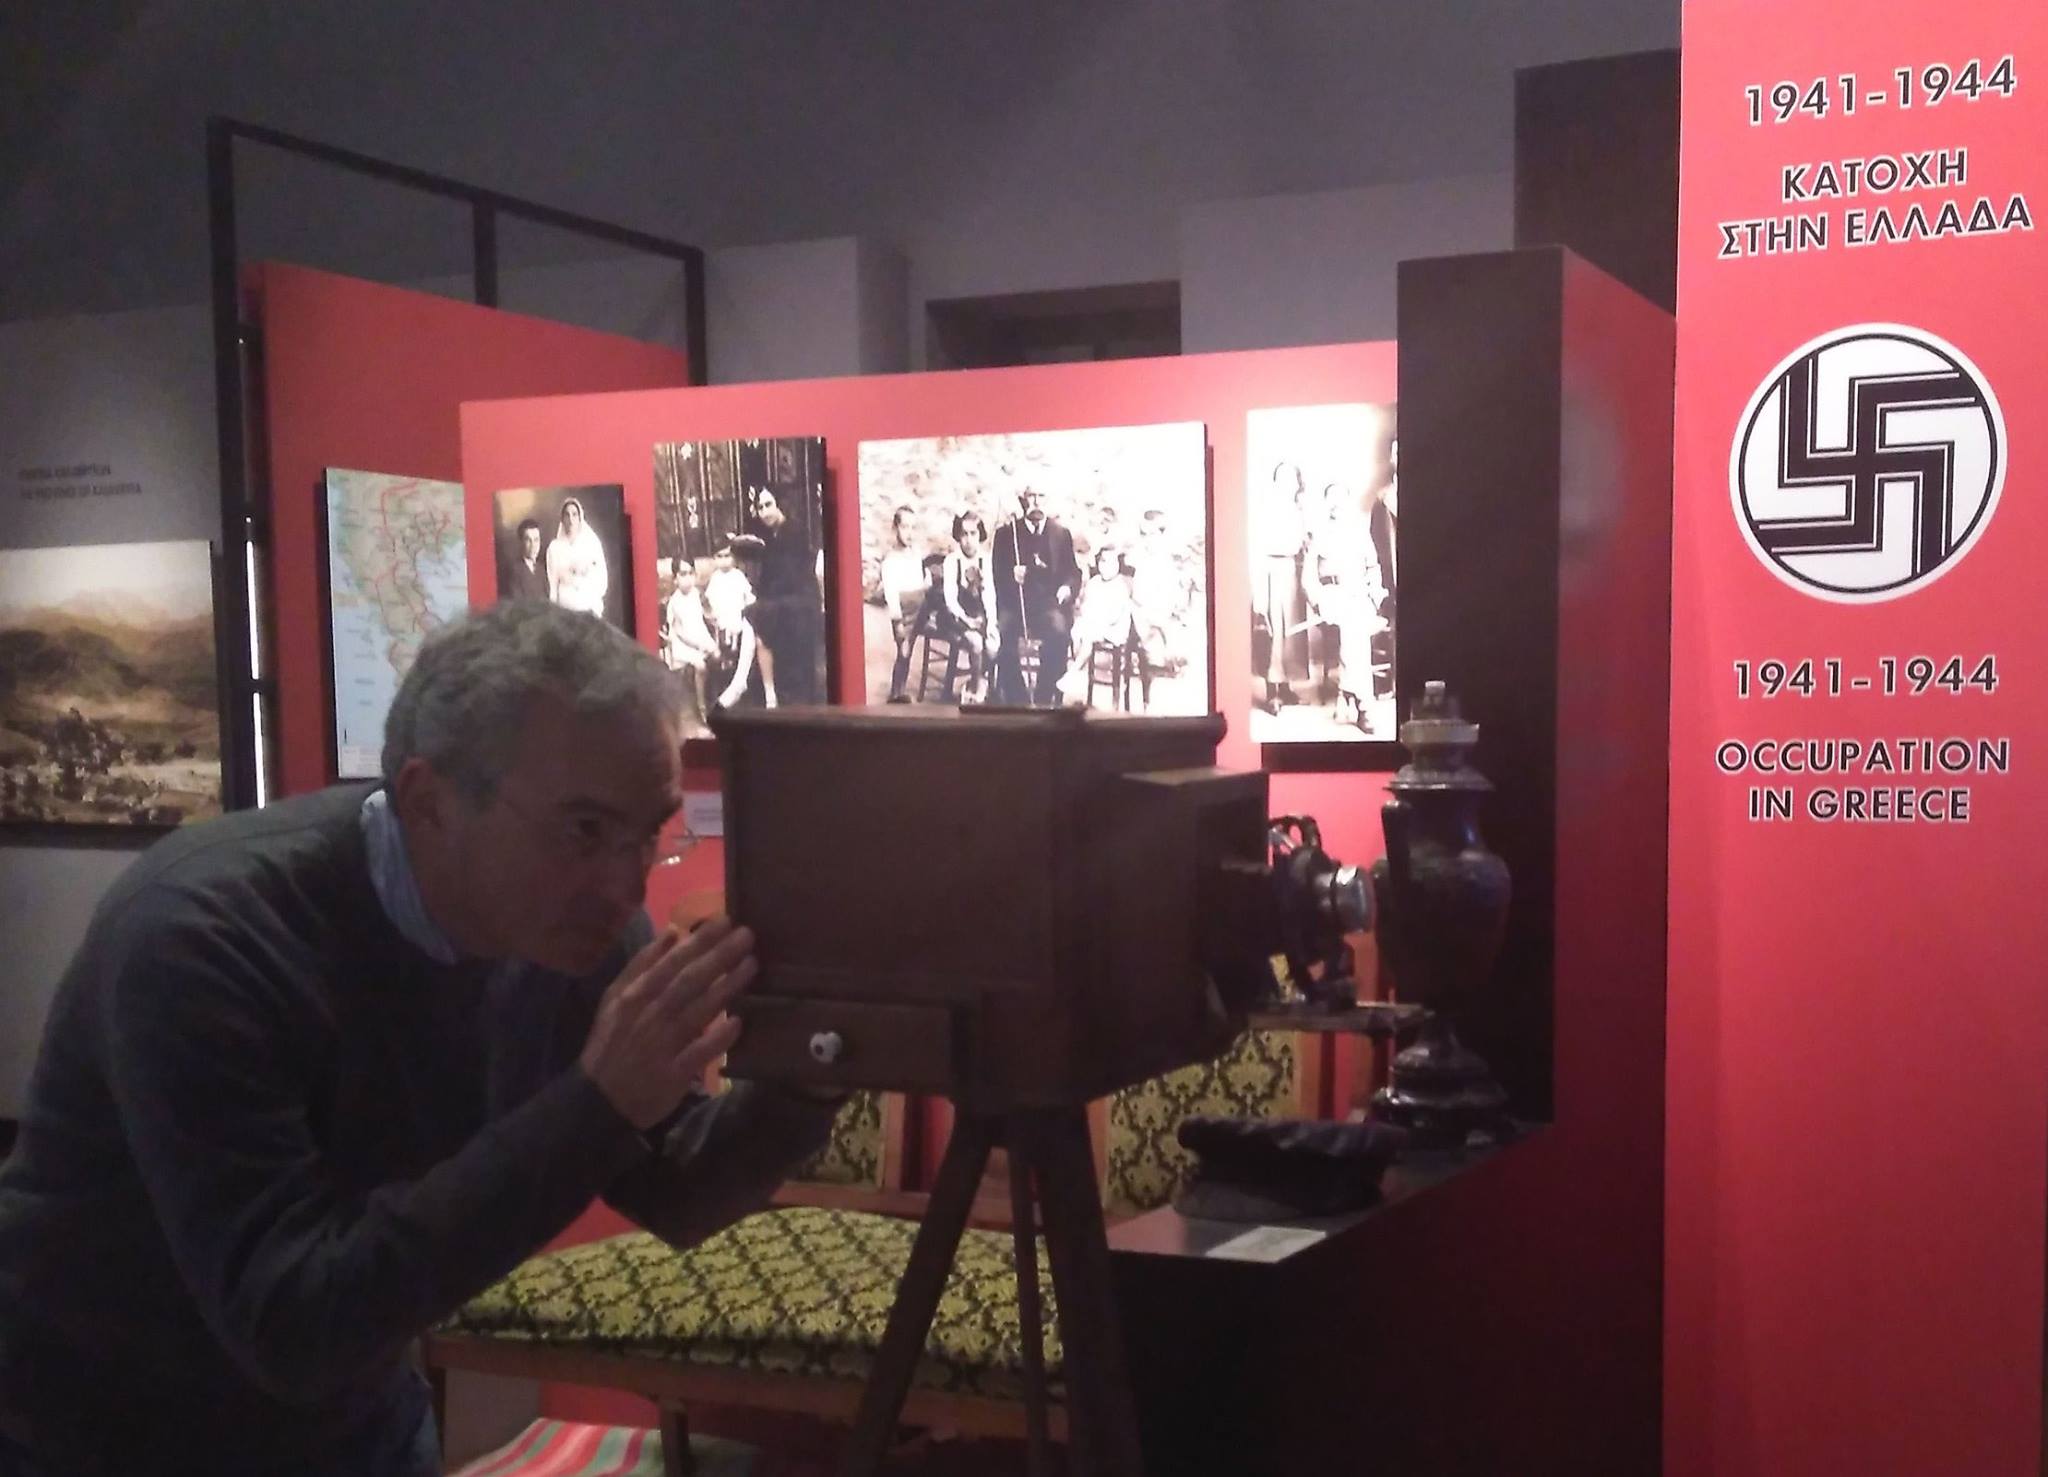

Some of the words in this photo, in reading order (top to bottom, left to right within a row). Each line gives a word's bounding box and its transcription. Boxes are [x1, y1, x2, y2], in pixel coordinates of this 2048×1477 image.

[1746, 55, 2015, 125] 1941-1944
[1783, 148, 1967, 203] ΚΑΤΟΧΗ
[1718, 214, 1827, 259] ΣΤΗΝ
[1845, 195, 2033, 245] ΕΛΛΑΔΑ
[1734, 655, 1998, 698] 1941-1944
[1716, 738, 2009, 774] OCCUPATION
[1749, 787, 1793, 821] IN
[1807, 786, 1970, 822] GREECE
